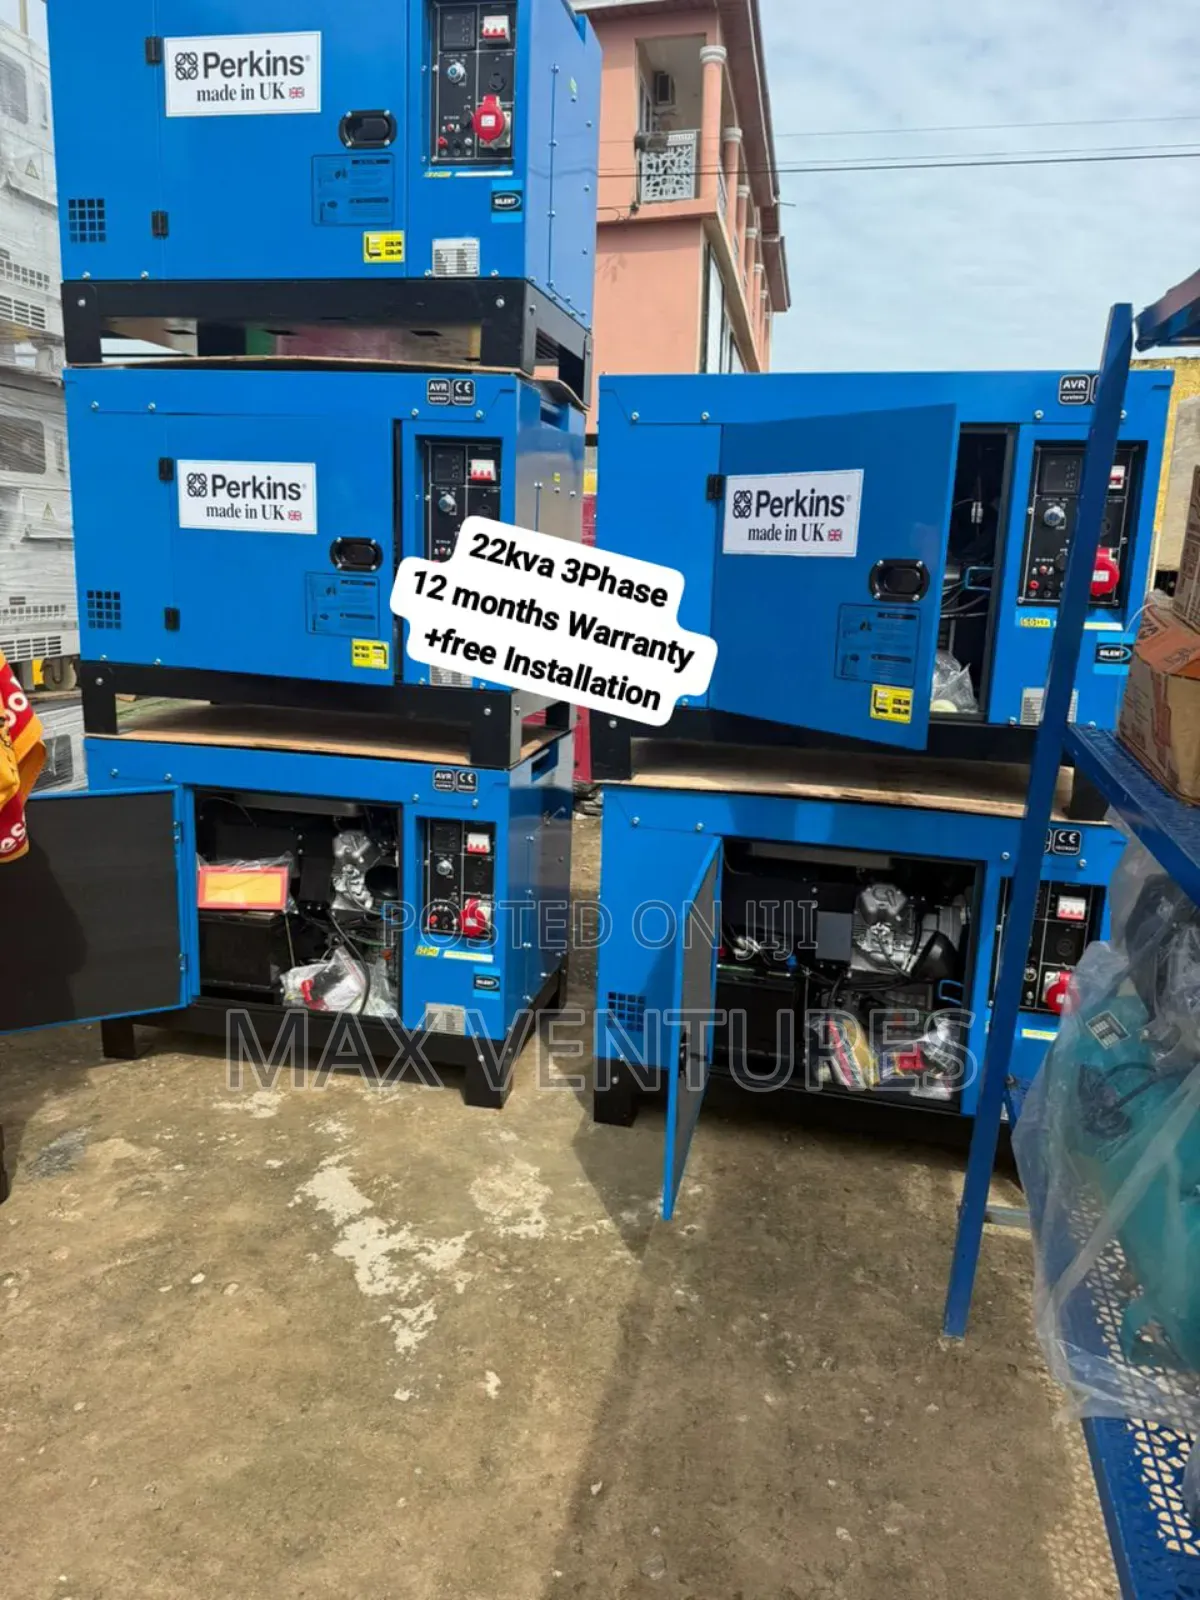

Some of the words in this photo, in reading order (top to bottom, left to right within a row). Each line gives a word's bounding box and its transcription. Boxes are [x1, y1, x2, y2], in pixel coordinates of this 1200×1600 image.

[203, 49, 305, 79] Perkins
[196, 84, 237, 102] made
[241, 83, 255, 101] in
[259, 82, 286, 100] UK
[429, 382, 448, 391] AVR
[1063, 379, 1086, 390] AVR
[211, 474, 302, 501] Perkins
[206, 503, 242, 519] made
[245, 503, 258, 519] in
[261, 504, 285, 521] UK
[755, 488, 845, 519] Perkins
[748, 523, 782, 541] made
[784, 523, 797, 541] in
[801, 523, 825, 542] UK
